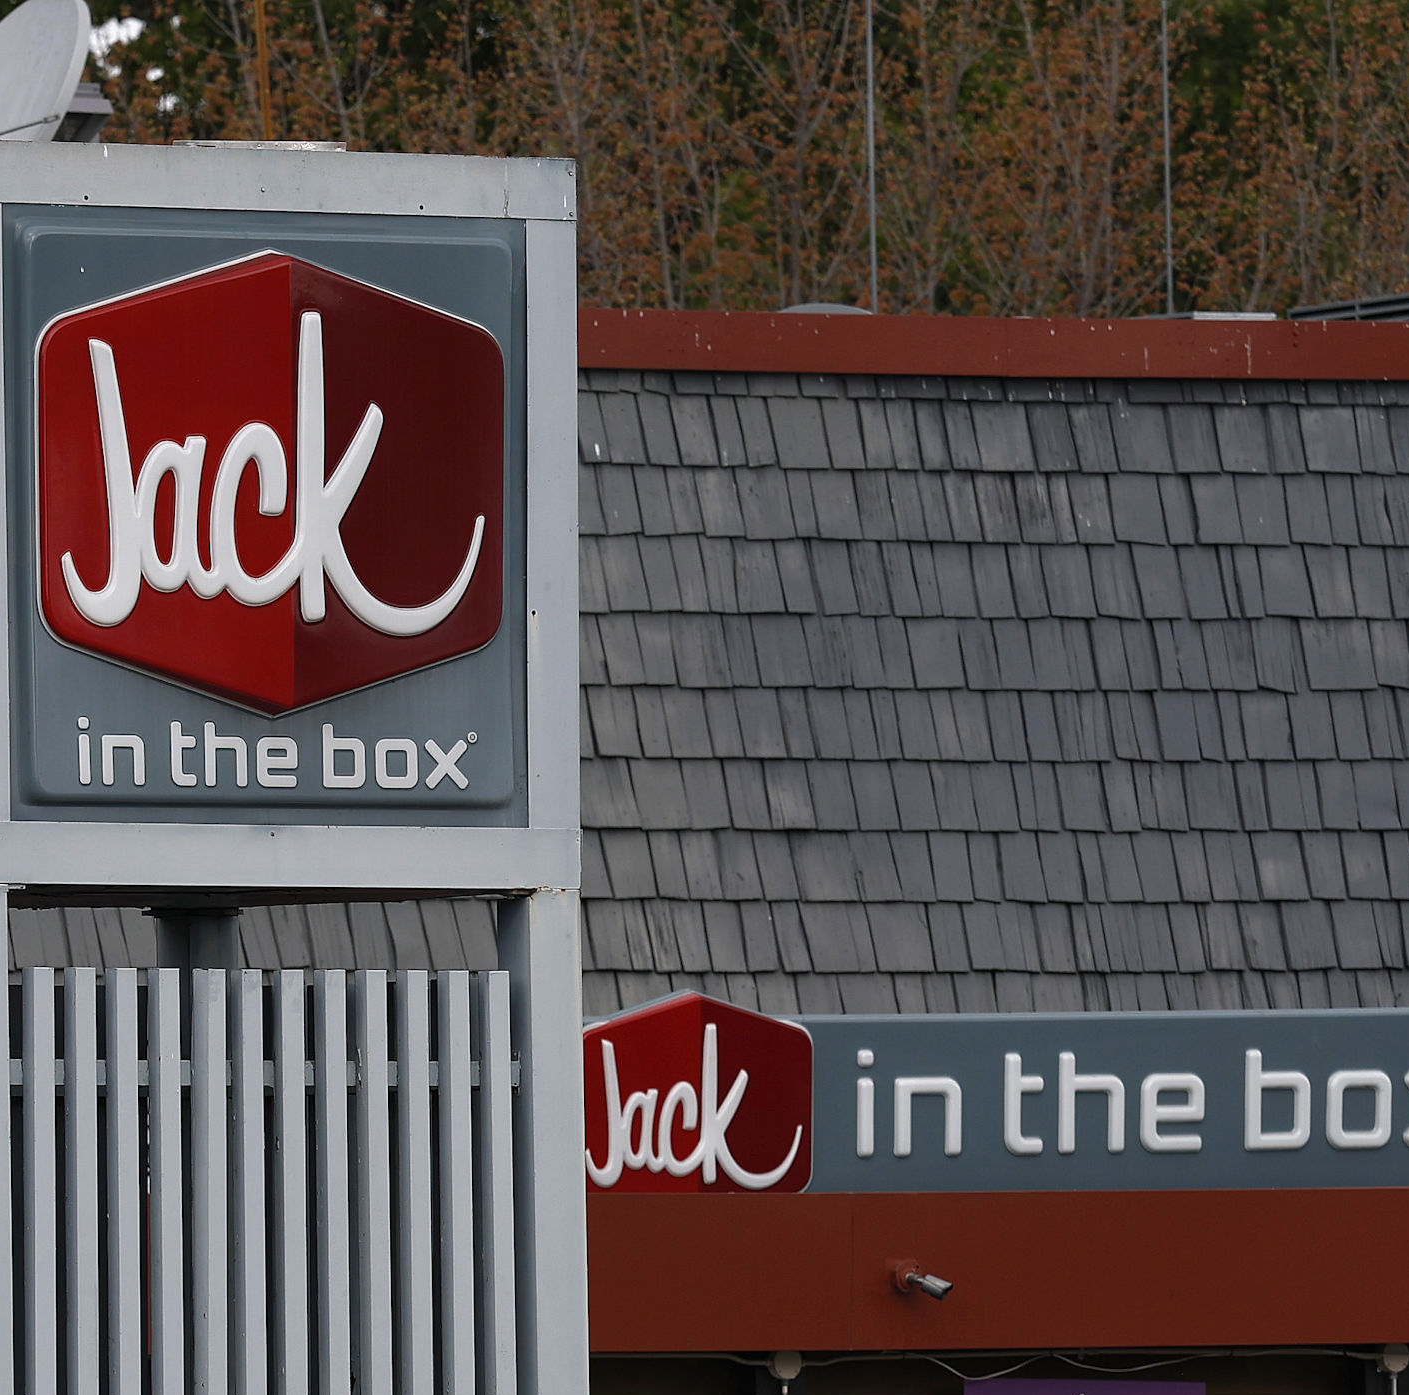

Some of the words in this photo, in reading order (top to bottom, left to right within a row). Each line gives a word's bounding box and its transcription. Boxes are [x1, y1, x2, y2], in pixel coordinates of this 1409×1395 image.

[60, 311, 485, 637] Jack
[76, 716, 146, 787] in
[169, 720, 298, 789] the
[585, 1022, 803, 1188] Jack
[855, 1049, 963, 1157] in
[1003, 1050, 1207, 1155] the
